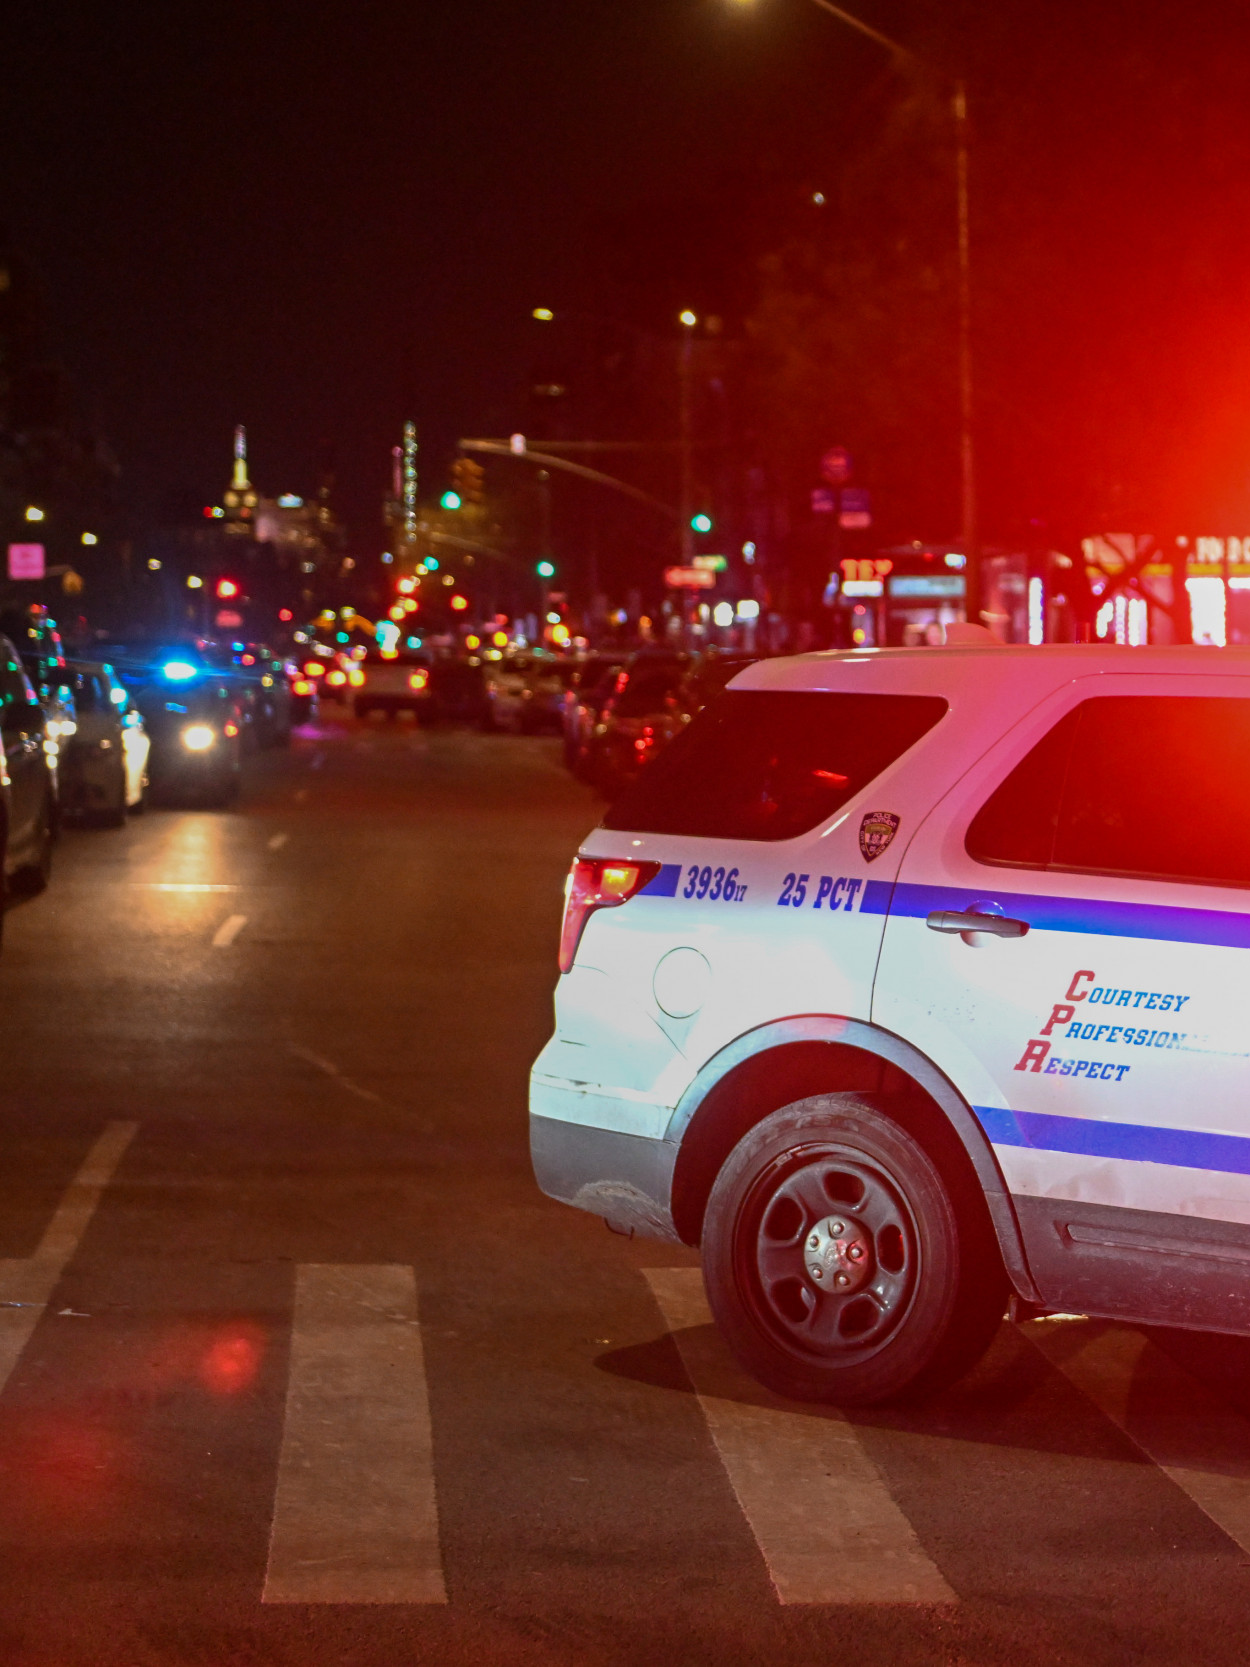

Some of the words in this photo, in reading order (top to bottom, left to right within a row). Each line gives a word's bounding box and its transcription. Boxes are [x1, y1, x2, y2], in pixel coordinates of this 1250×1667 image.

[683, 865, 739, 902] 3936
[777, 872, 810, 908] 25
[813, 876, 863, 912] PCT
[1065, 970, 1190, 1012] COURTESY
[1013, 1039, 1131, 1082] RESPECT
